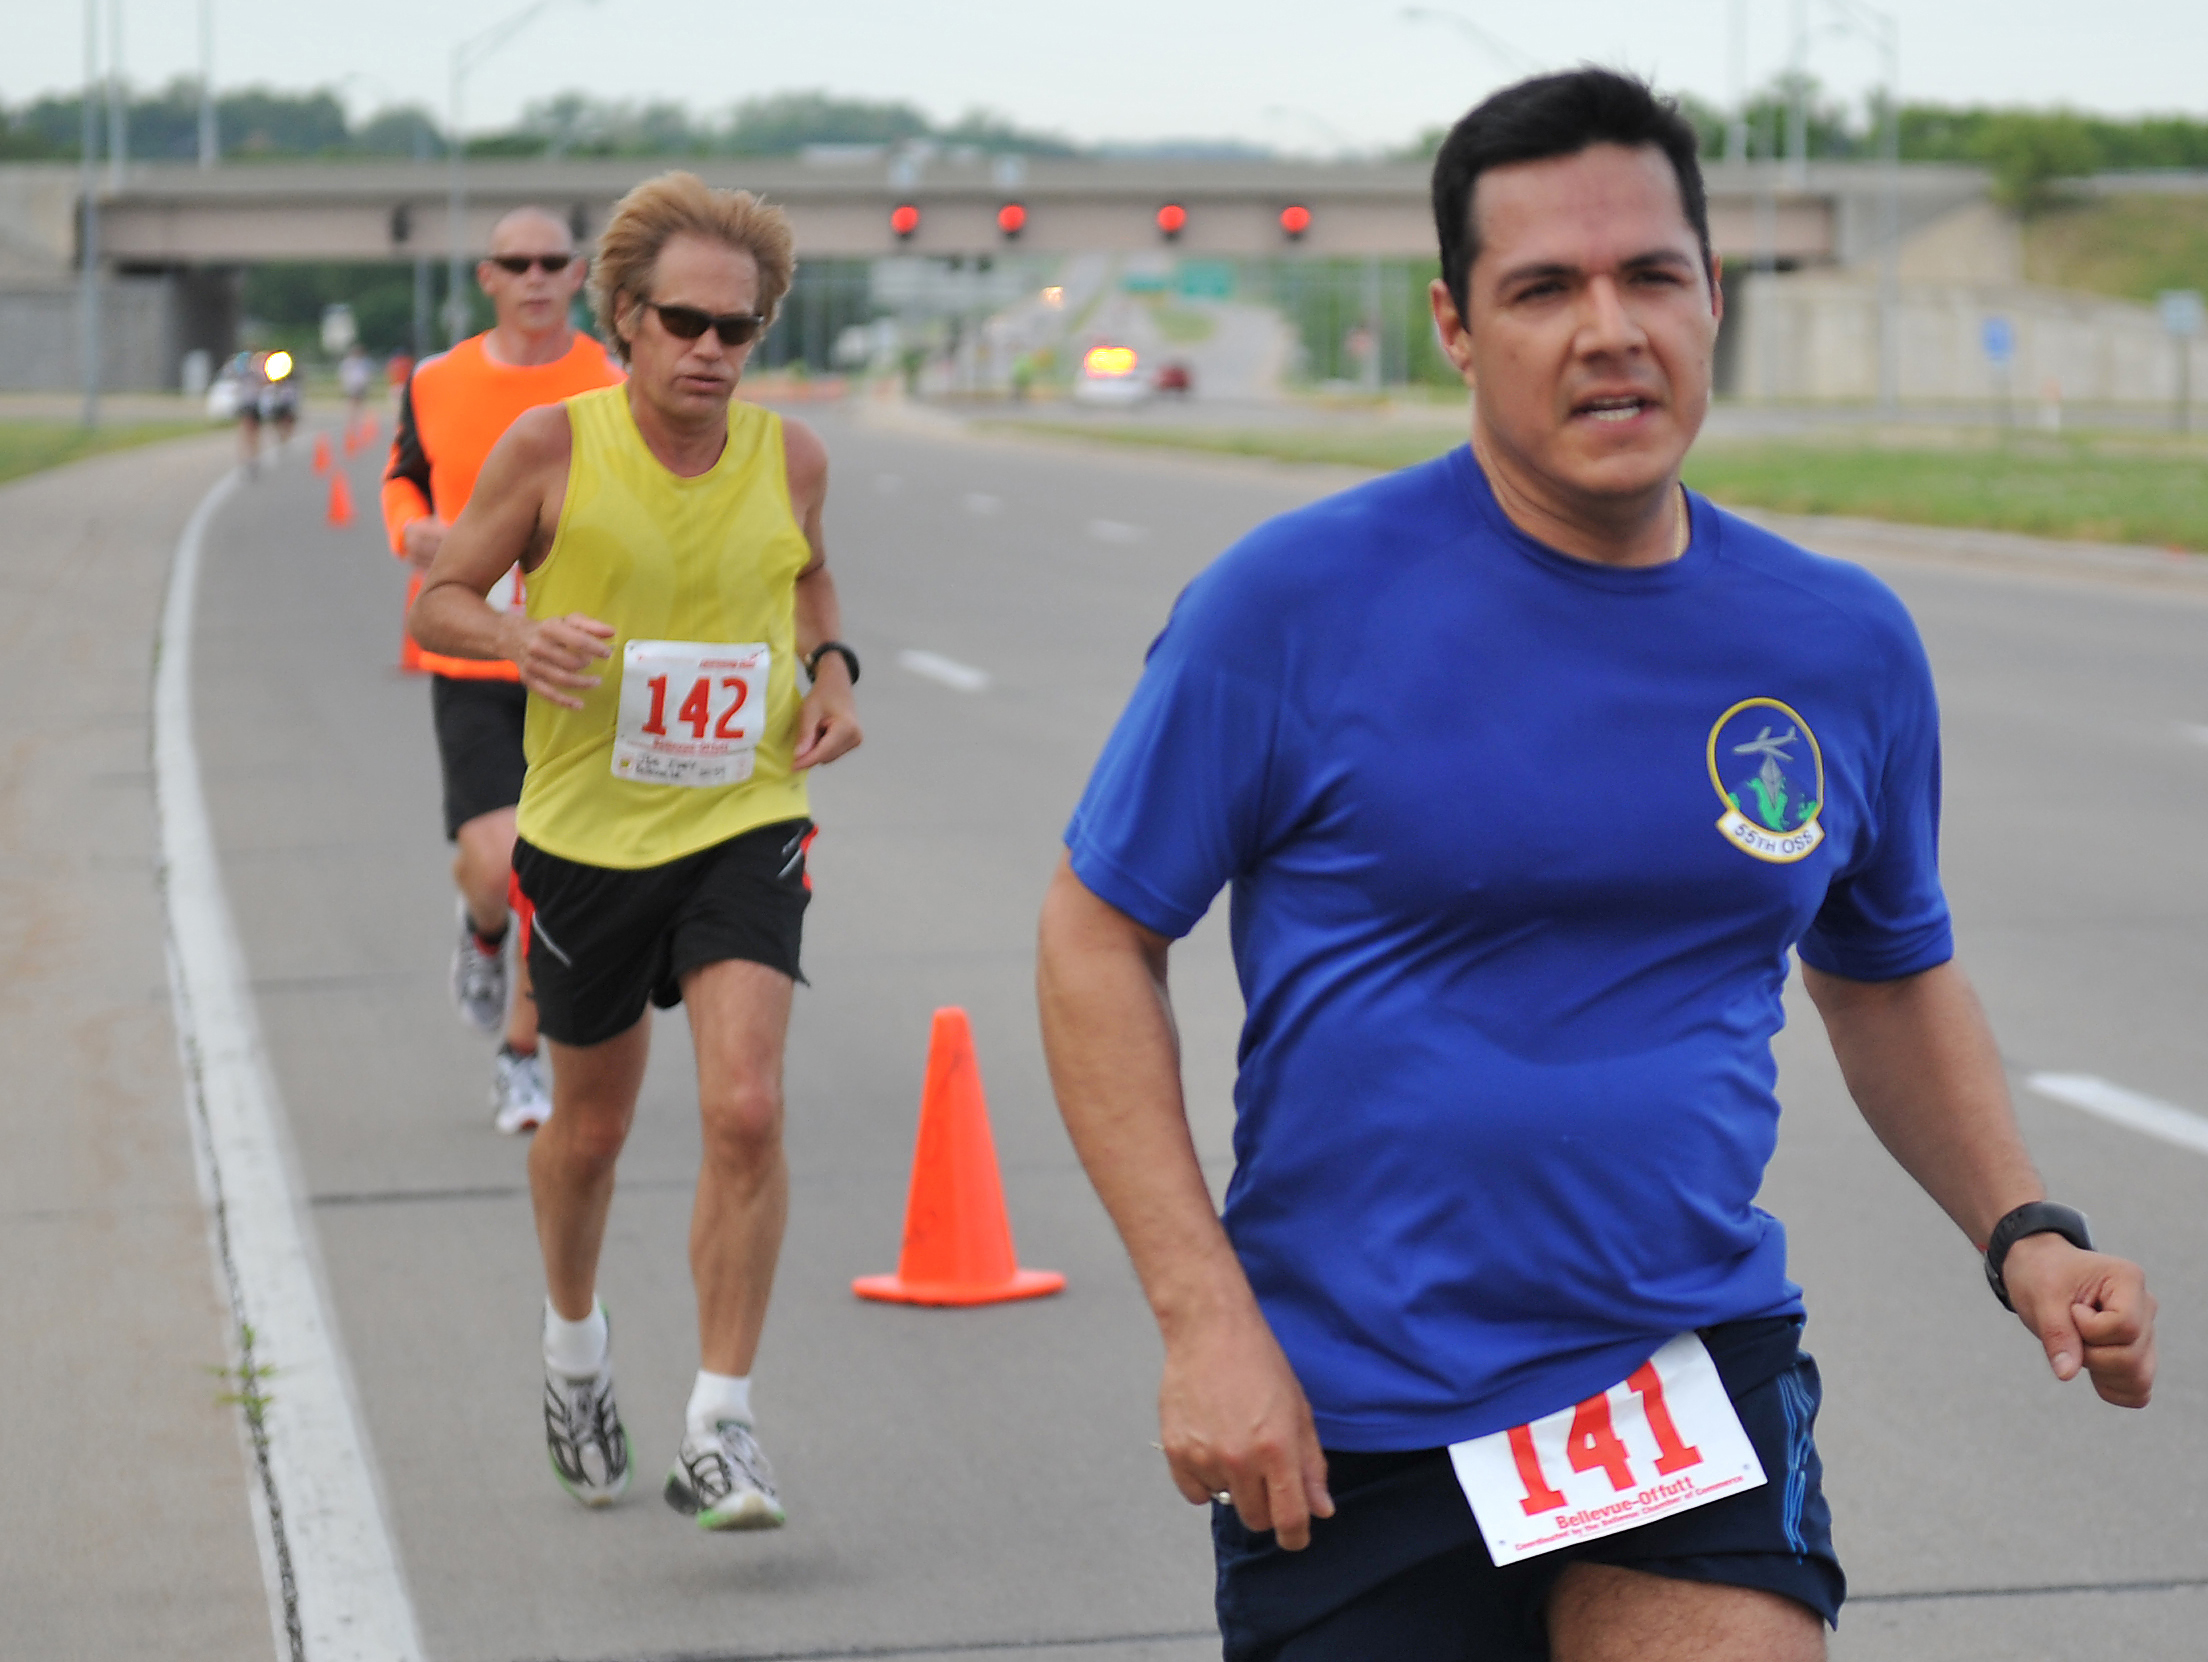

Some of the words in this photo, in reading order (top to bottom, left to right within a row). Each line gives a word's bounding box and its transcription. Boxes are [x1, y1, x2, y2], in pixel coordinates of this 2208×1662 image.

[641, 674, 747, 739] 142
[1735, 824, 1776, 852] 55TH
[1782, 831, 1813, 853] OSS
[1507, 1360, 1703, 1516] 141
[1555, 1476, 1694, 1529] Bellevue-Offutt
